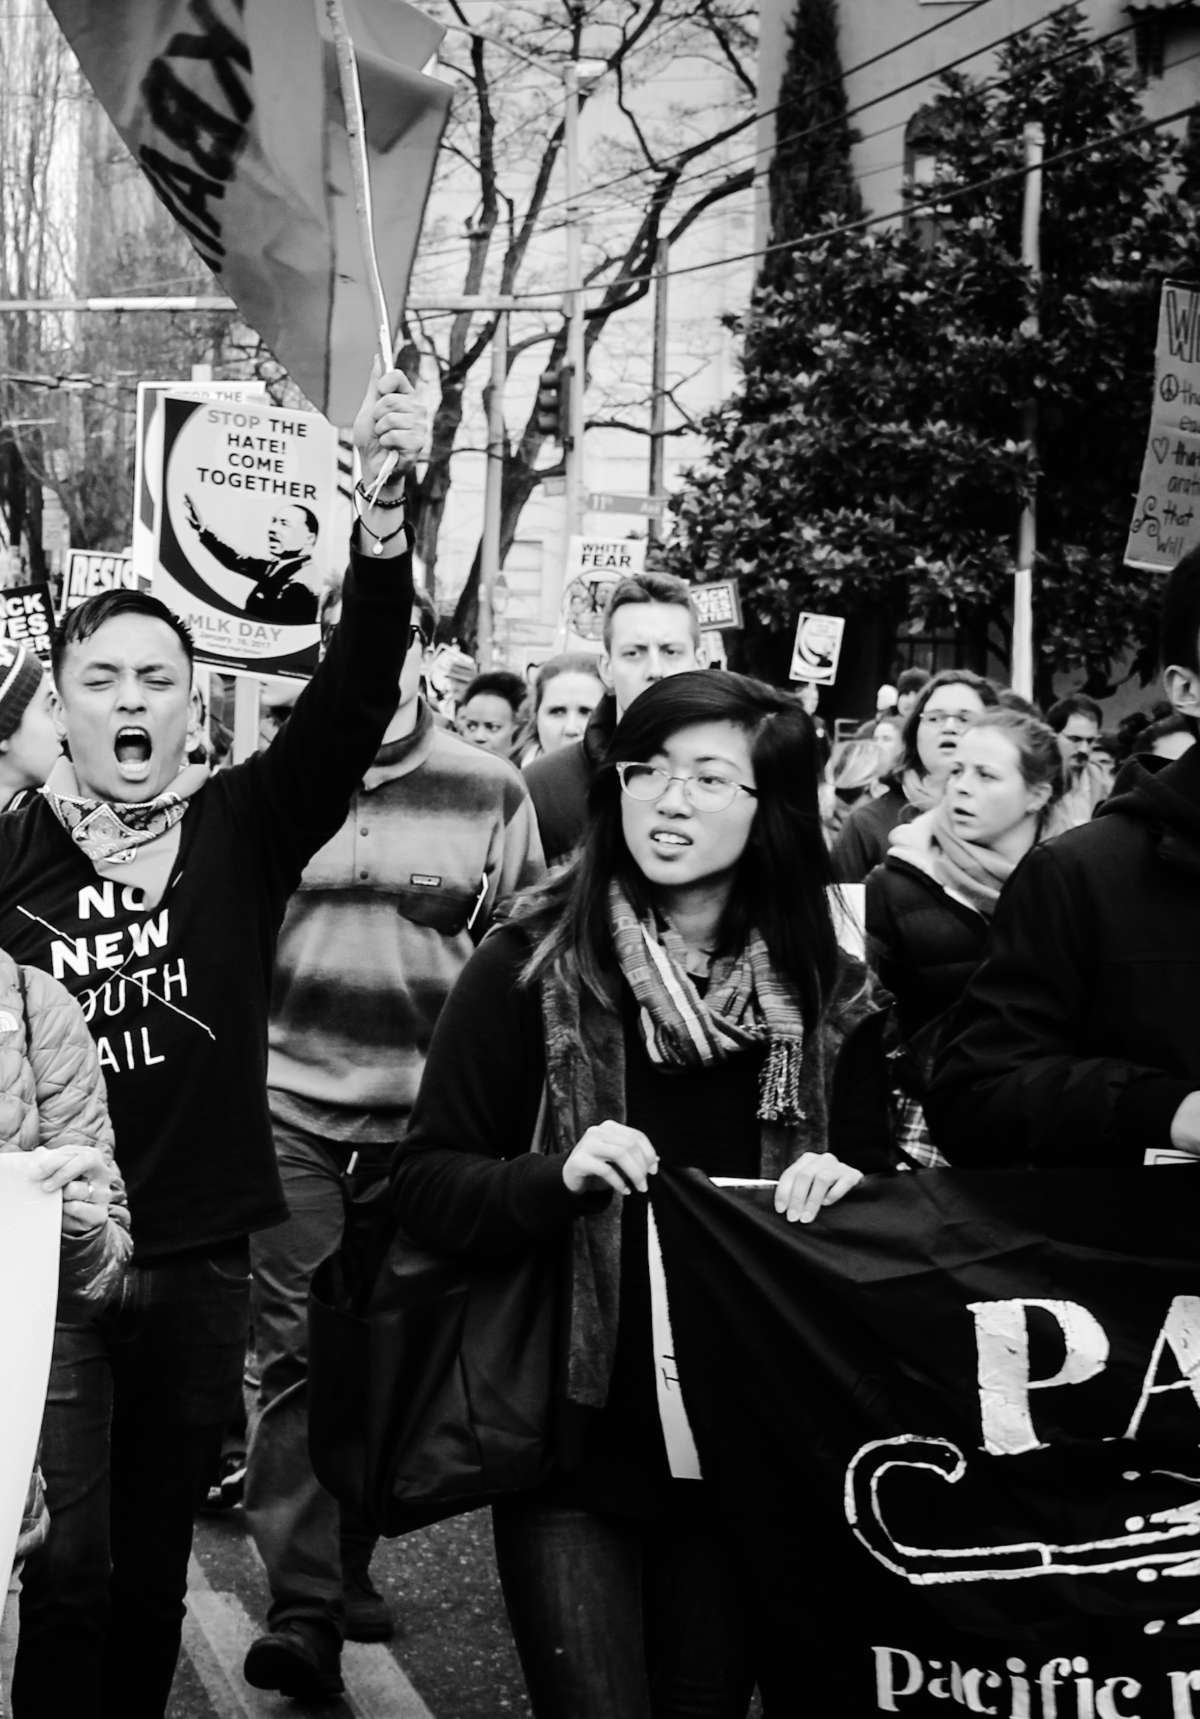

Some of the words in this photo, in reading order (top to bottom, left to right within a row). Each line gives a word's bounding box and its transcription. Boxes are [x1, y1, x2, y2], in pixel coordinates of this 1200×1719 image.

[208, 409, 260, 429] STOP
[269, 418, 308, 438] THE
[228, 433, 286, 455] HATE!
[228, 453, 285, 473] COME
[196, 467, 317, 500] TOGETHER
[580, 554, 632, 567] FEAR
[582, 543, 629, 554] WHITE
[187, 613, 231, 634] MLK
[239, 622, 283, 642] DAY
[78, 881, 146, 919] NO
[50, 908, 169, 980] NEW
[75, 958, 188, 1022] OUTH
[98, 1026, 165, 1072] AIL
[871, 1646, 1142, 1719] Pacific
